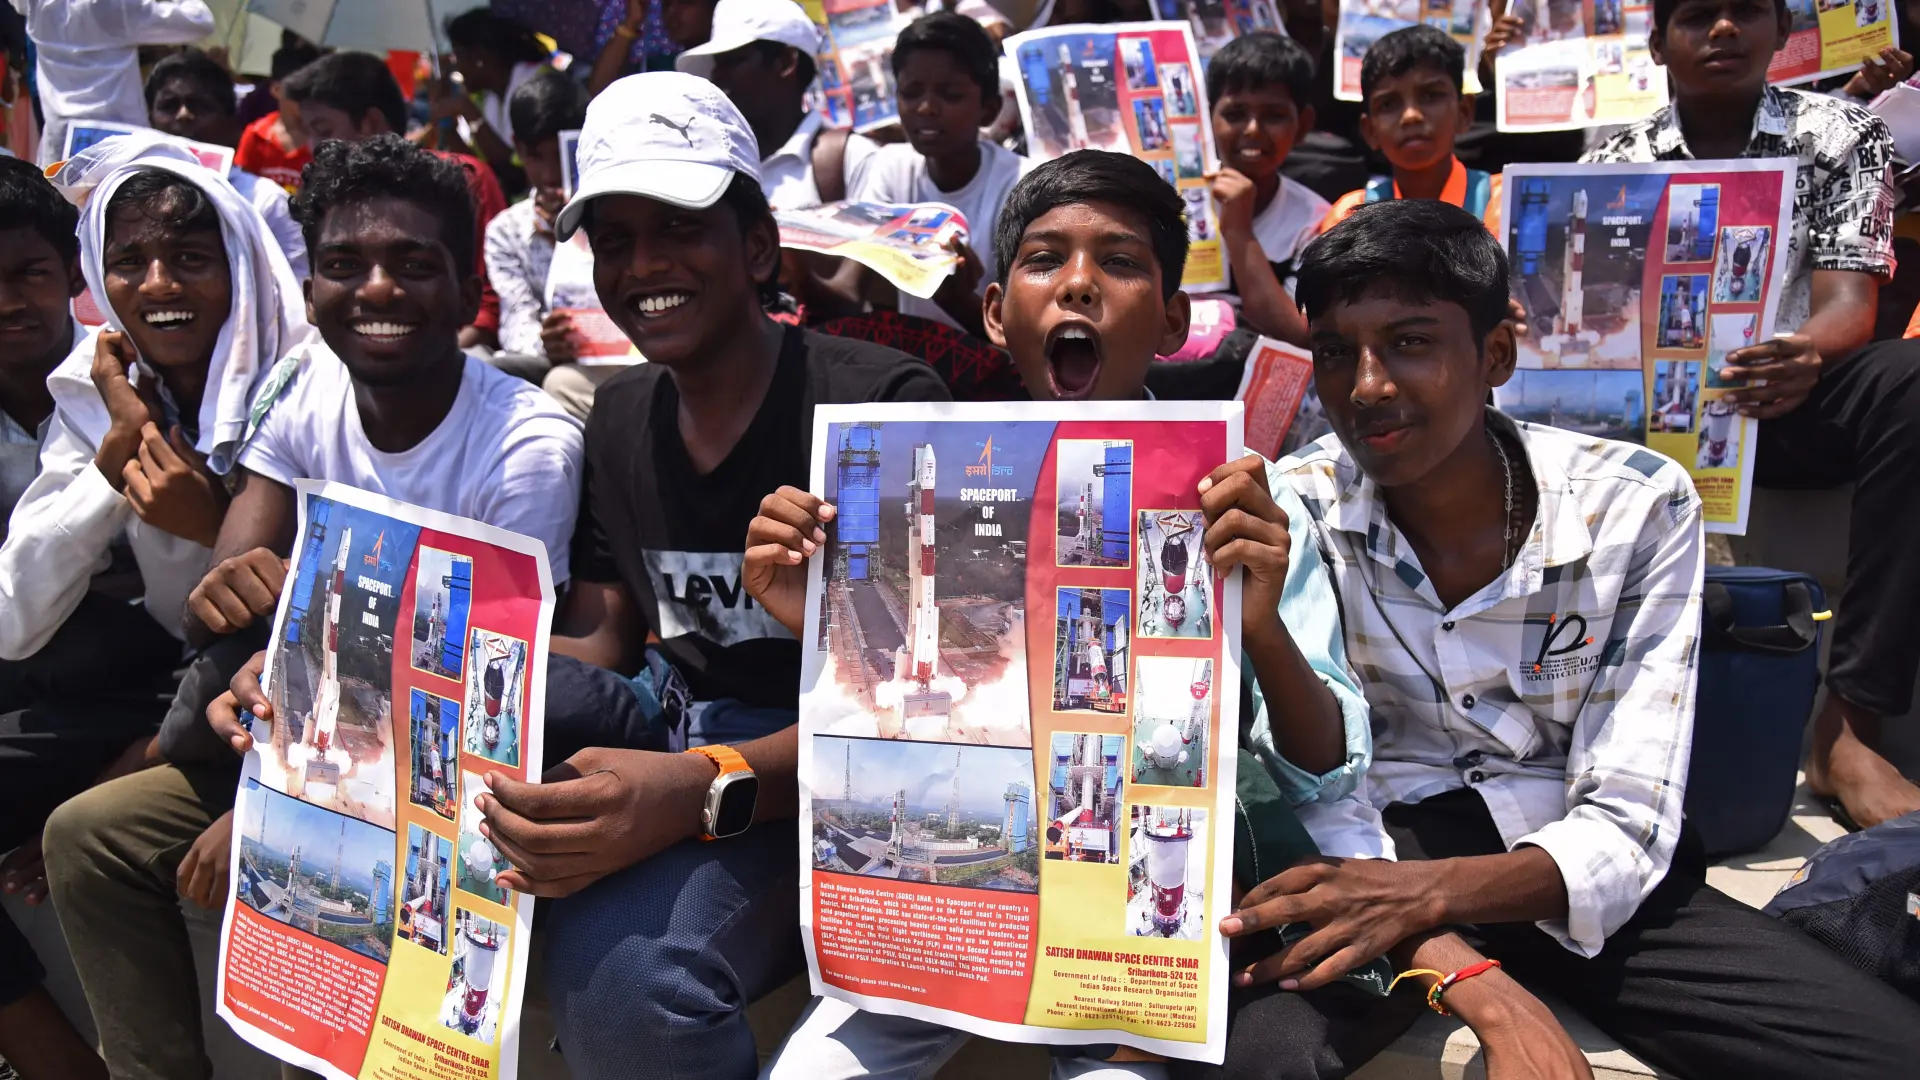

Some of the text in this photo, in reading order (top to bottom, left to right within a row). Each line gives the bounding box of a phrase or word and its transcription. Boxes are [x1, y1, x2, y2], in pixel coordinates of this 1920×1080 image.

[960, 488, 1017, 502] SPACEPORT
[982, 506, 994, 518] OF
[974, 524, 1002, 536] INDIA
[358, 575, 392, 598] SPACEPORT
[368, 596, 377, 610] OF
[362, 611, 380, 628] INDIA
[1046, 946, 1199, 969] SATISH DHAWAN SPACE CENTRE SHAR
[1054, 970, 1090, 980] Government
[1130, 978, 1167, 986] Department
[1128, 967, 1183, 980] Sriharikota-524
[1102, 984, 1121, 992] Space
[1124, 986, 1153, 994] Research
[1156, 989, 1196, 998] Organisation
[1074, 995, 1095, 1003] Nearest
[1098, 998, 1120, 1006] Railway
[382, 1015, 489, 1068] SATISH DHAWAN SPACE CENTRE SHAR
